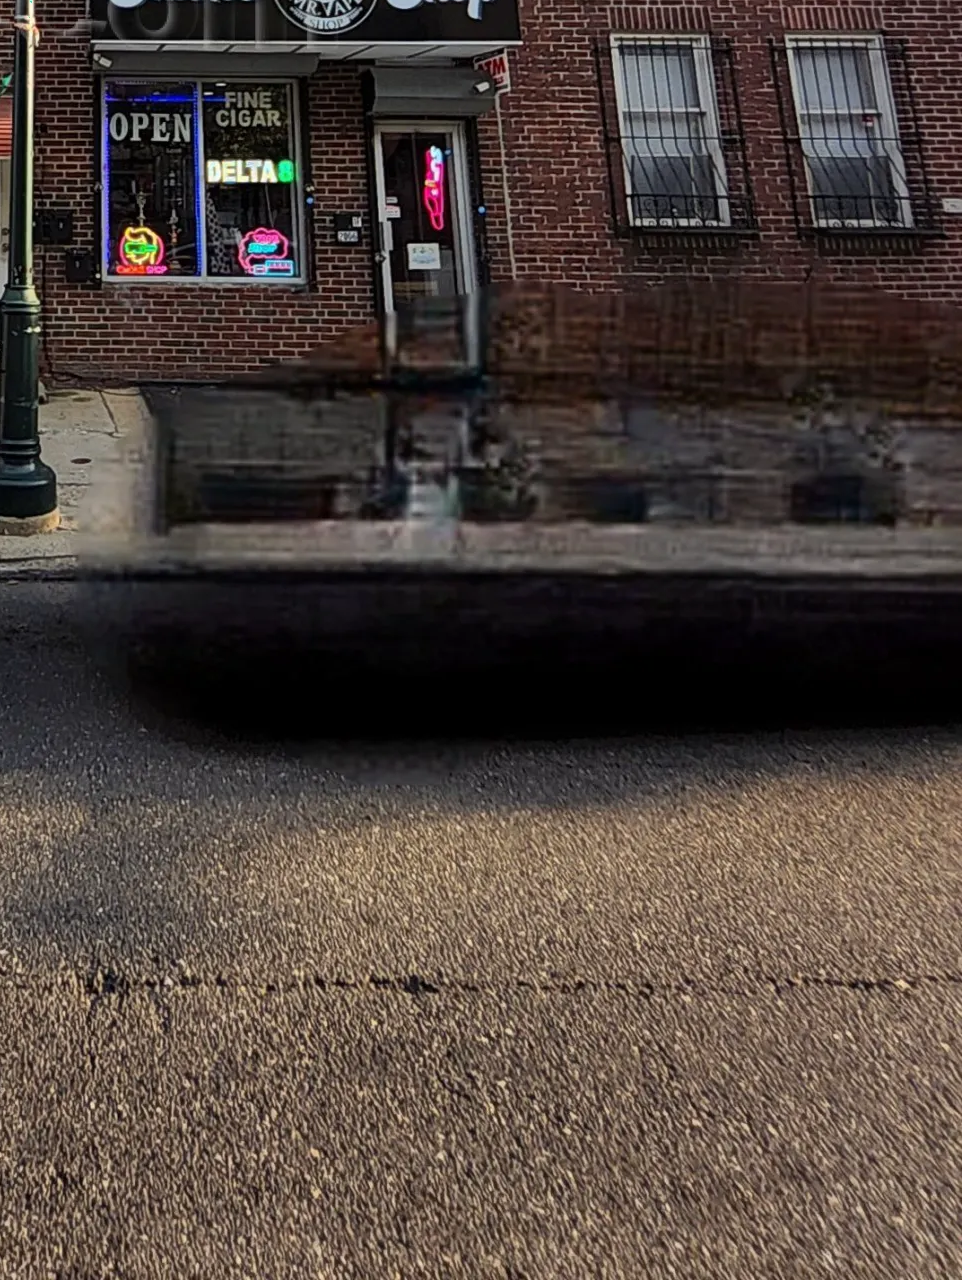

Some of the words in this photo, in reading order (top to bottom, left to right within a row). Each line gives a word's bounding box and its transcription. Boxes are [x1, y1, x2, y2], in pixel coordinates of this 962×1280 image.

[224, 92, 272, 108] FINE
[109, 113, 192, 142] OPEN
[216, 110, 282, 128] CIGAR
